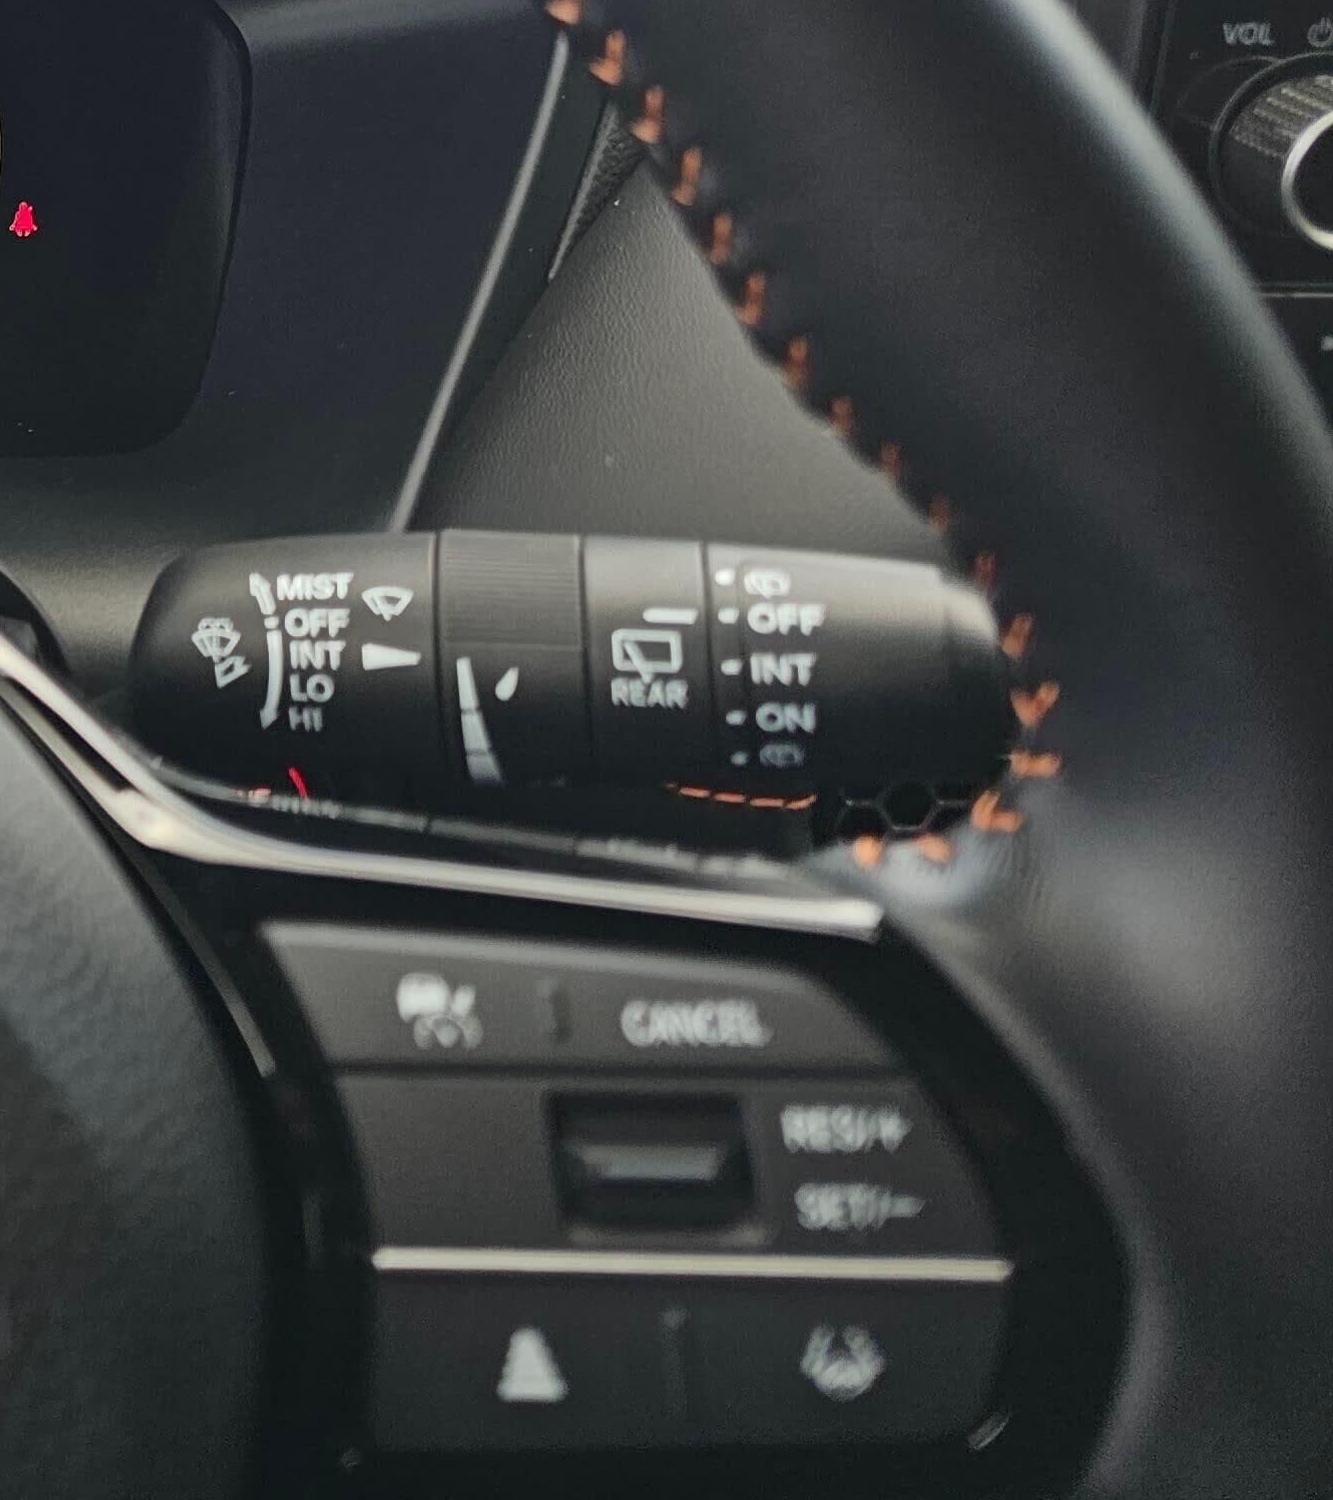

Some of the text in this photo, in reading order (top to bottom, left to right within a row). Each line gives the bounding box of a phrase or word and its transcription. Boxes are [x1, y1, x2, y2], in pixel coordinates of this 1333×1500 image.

[1222, 22, 1276, 46] VOL
[276, 571, 355, 601] MIST
[283, 608, 351, 638] OFF
[746, 602, 826, 636] OFF
[288, 640, 347, 671] INT
[749, 652, 819, 686] INT
[289, 674, 335, 703] LO
[610, 679, 690, 708] REAR
[287, 706, 324, 733] HI
[754, 701, 817, 735] ON
[620, 998, 771, 1047] CANCEL
